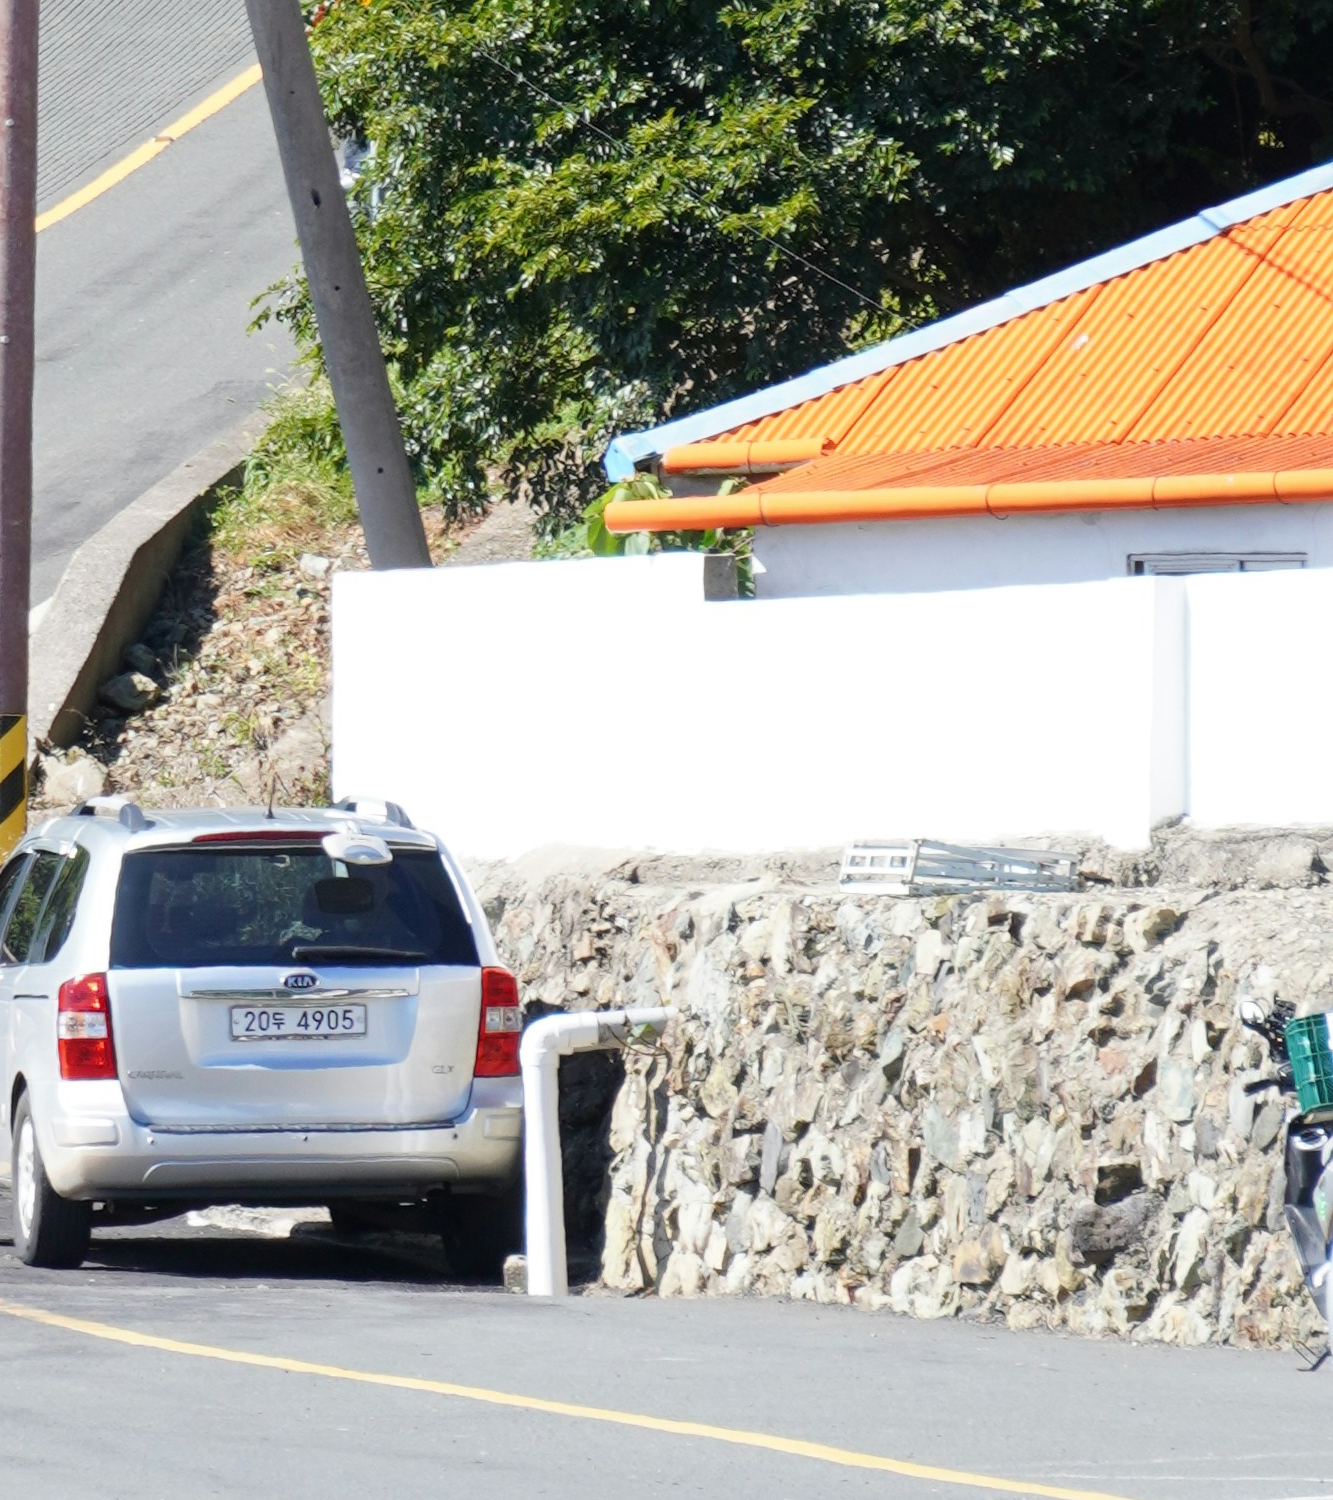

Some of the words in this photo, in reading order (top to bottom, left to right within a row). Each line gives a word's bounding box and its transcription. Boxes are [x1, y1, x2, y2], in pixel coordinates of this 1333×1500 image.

[287, 976, 314, 988] KIA
[244, 1011, 285, 1032] 20두
[297, 1009, 355, 1031] 4905
